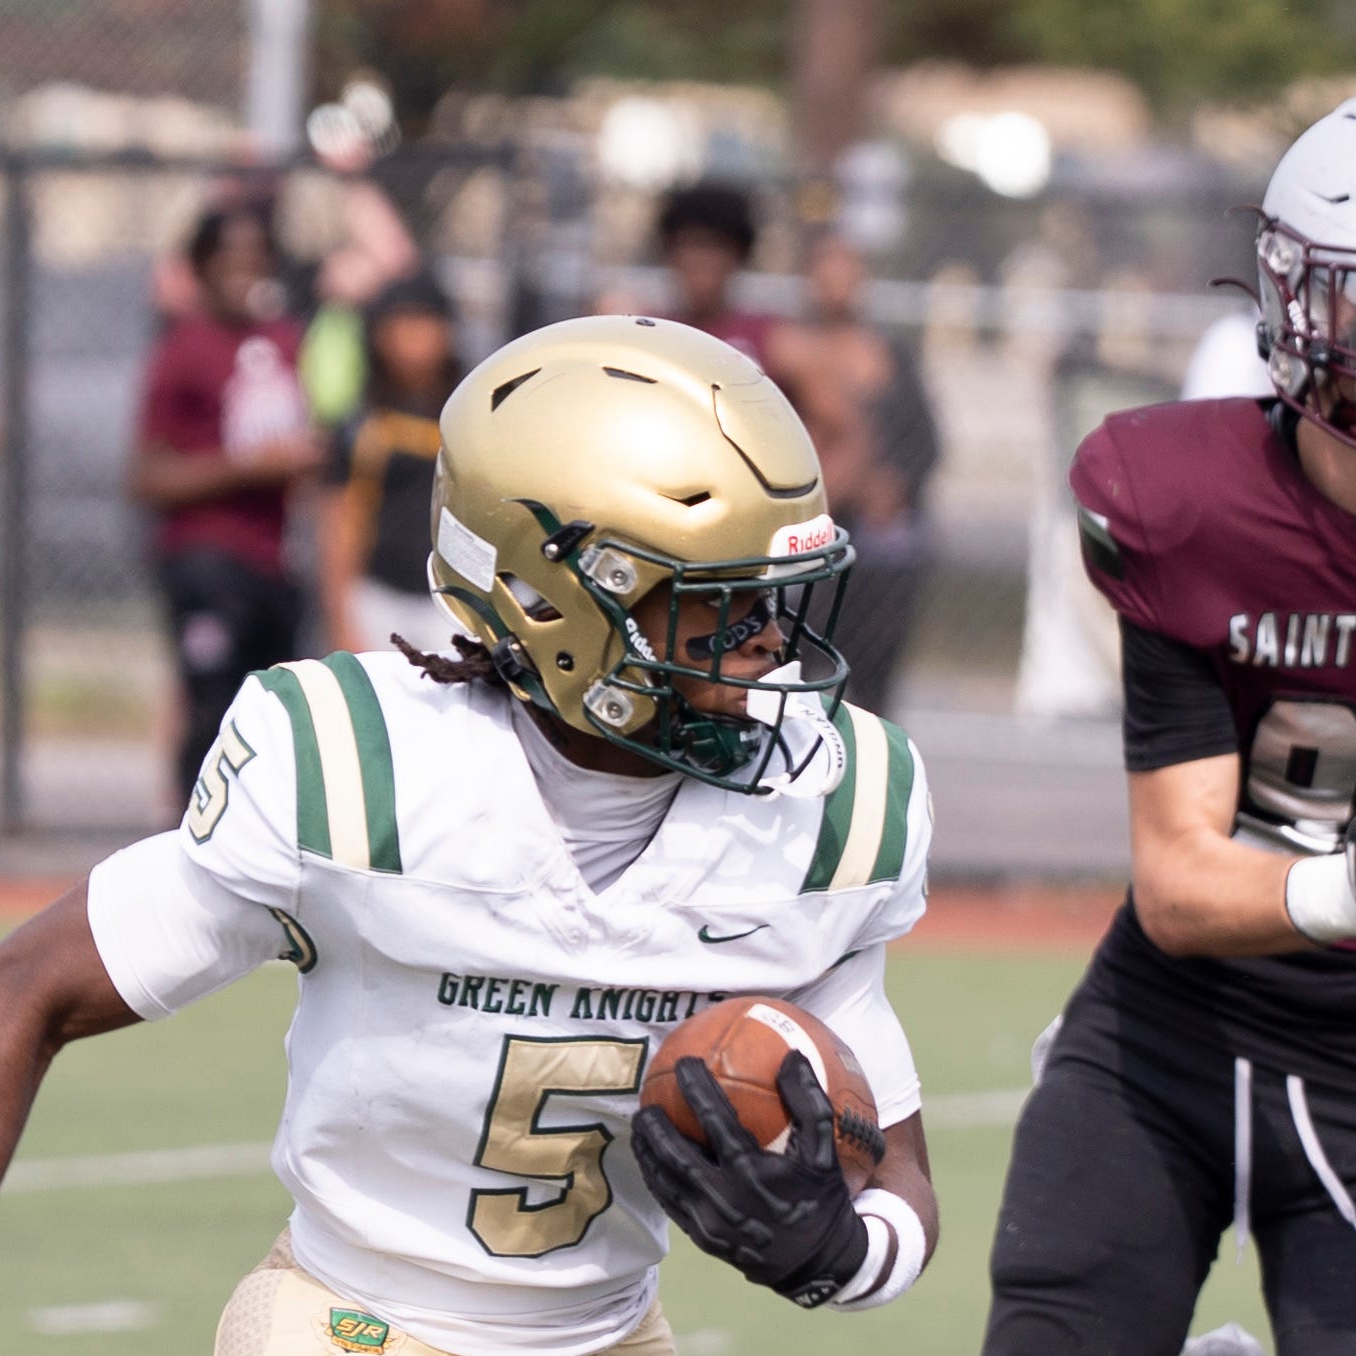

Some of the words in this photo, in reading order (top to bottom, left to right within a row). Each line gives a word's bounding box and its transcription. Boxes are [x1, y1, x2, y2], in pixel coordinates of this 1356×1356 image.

[188, 717, 257, 845] 5
[436, 972, 560, 1018] GREEN
[465, 1033, 650, 1259] 5
[336, 1317, 384, 1340] SJR
